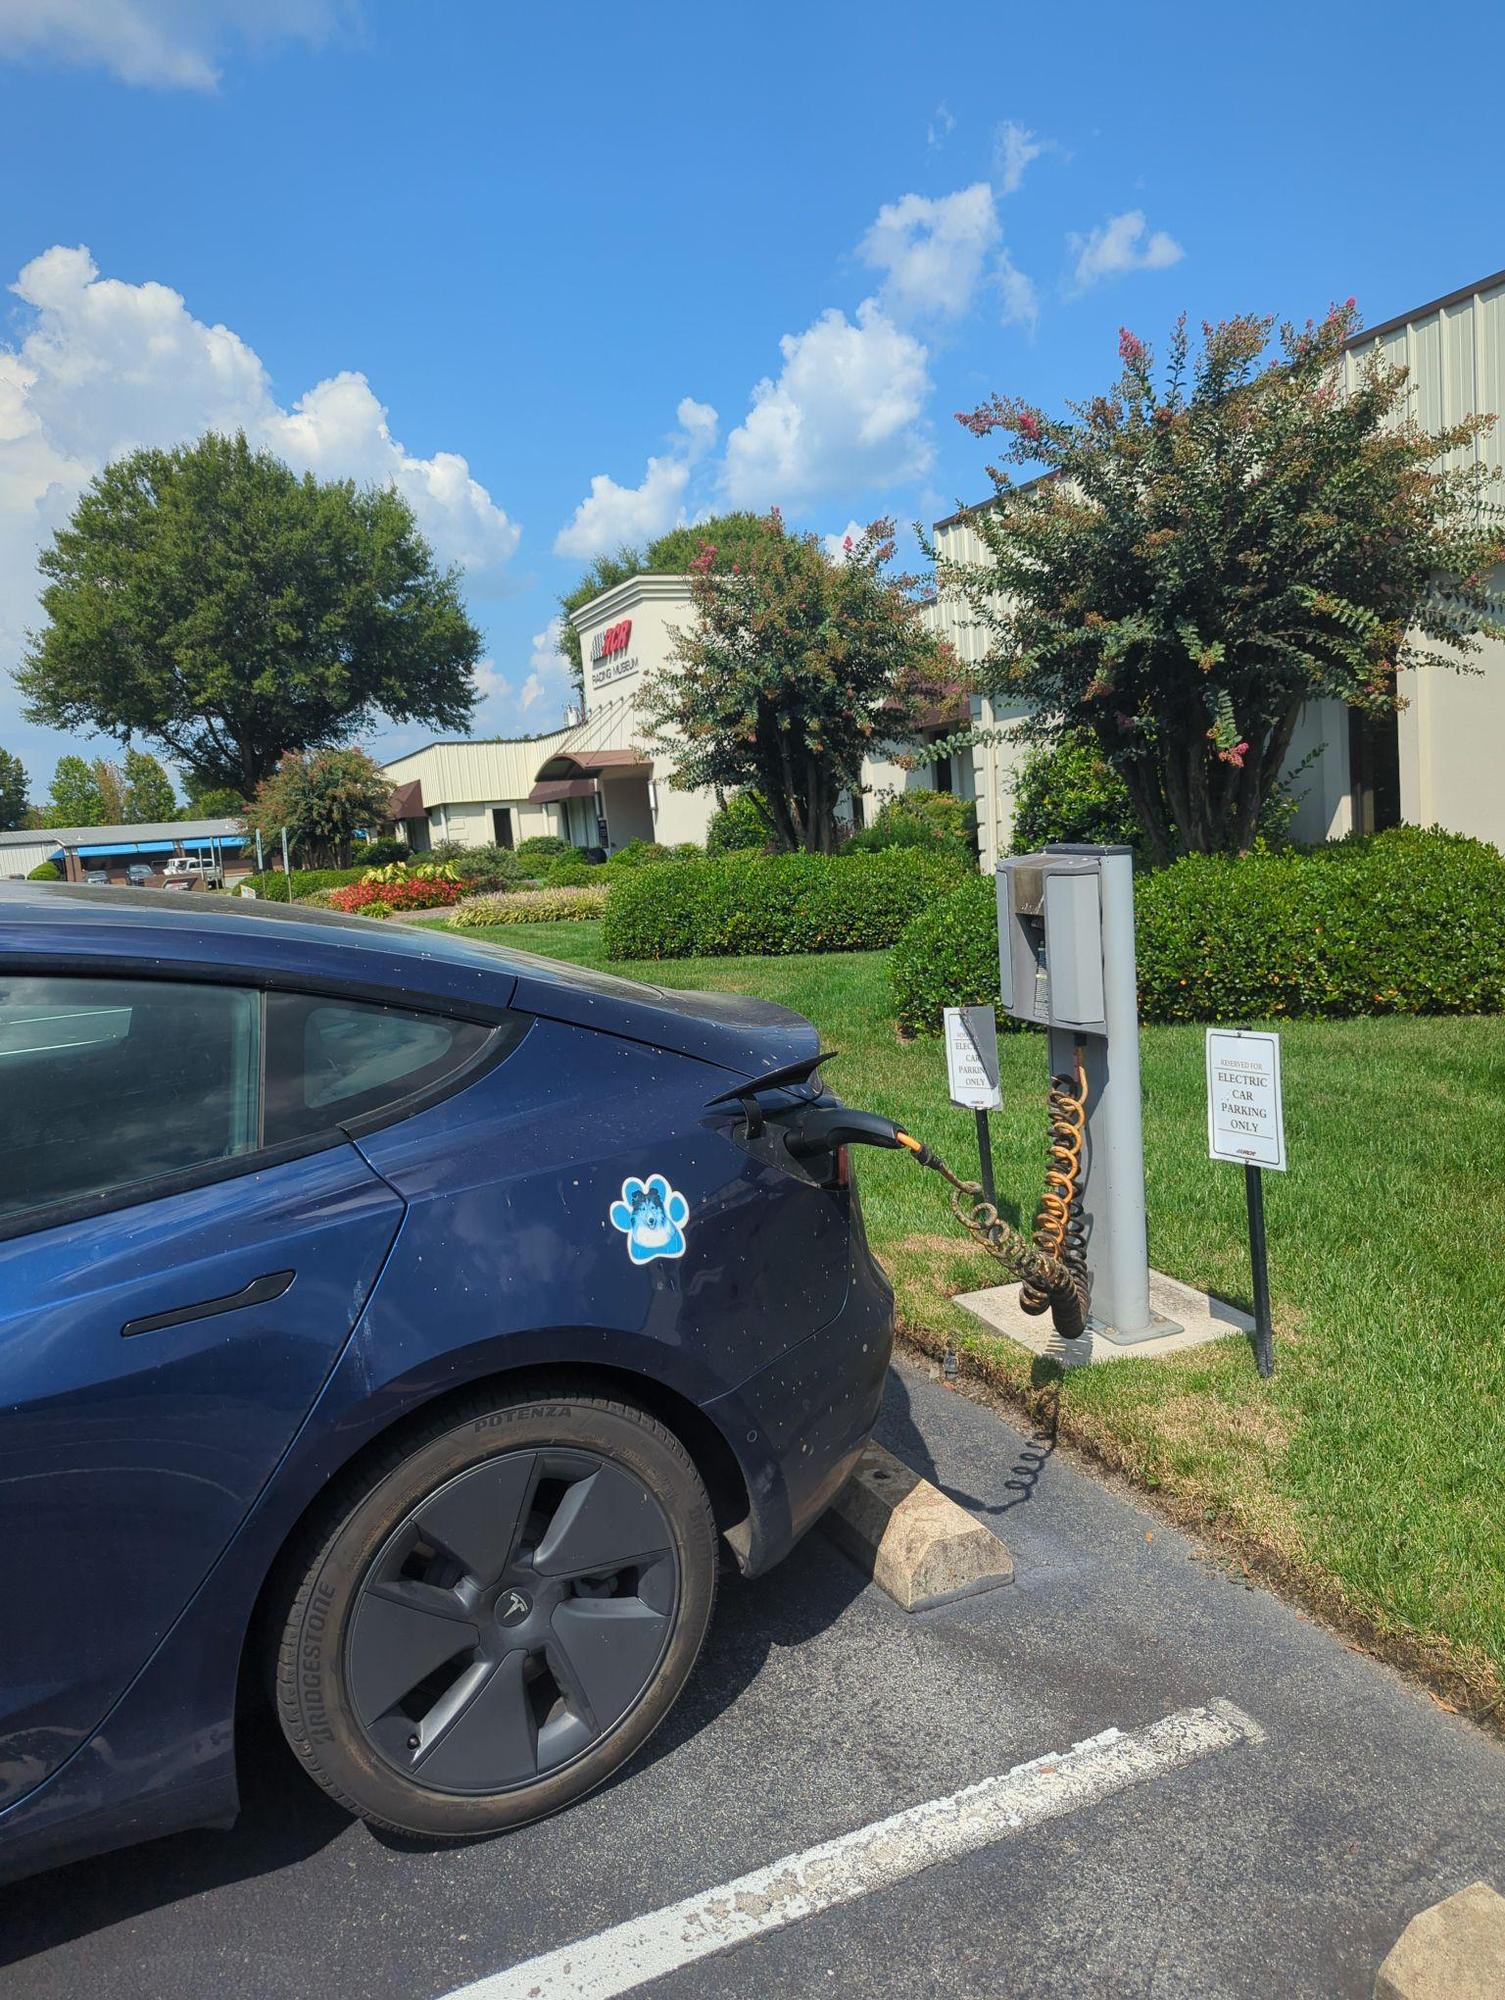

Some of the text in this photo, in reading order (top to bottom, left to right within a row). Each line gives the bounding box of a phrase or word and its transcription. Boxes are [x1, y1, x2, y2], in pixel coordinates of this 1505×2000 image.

[612, 656, 639, 674] MUSEUM
[958, 1065, 985, 1074] PARKIN
[965, 1078, 985, 1086] ONLY
[1218, 1072, 1268, 1087] ELECTRIC
[1232, 1089, 1254, 1101] CAR
[1221, 1102, 1267, 1118] PARKING
[1230, 1119, 1258, 1132] ONLY
[474, 1406, 572, 1432] POTENZA
[302, 1581, 336, 1745] BRIDGESTONE
